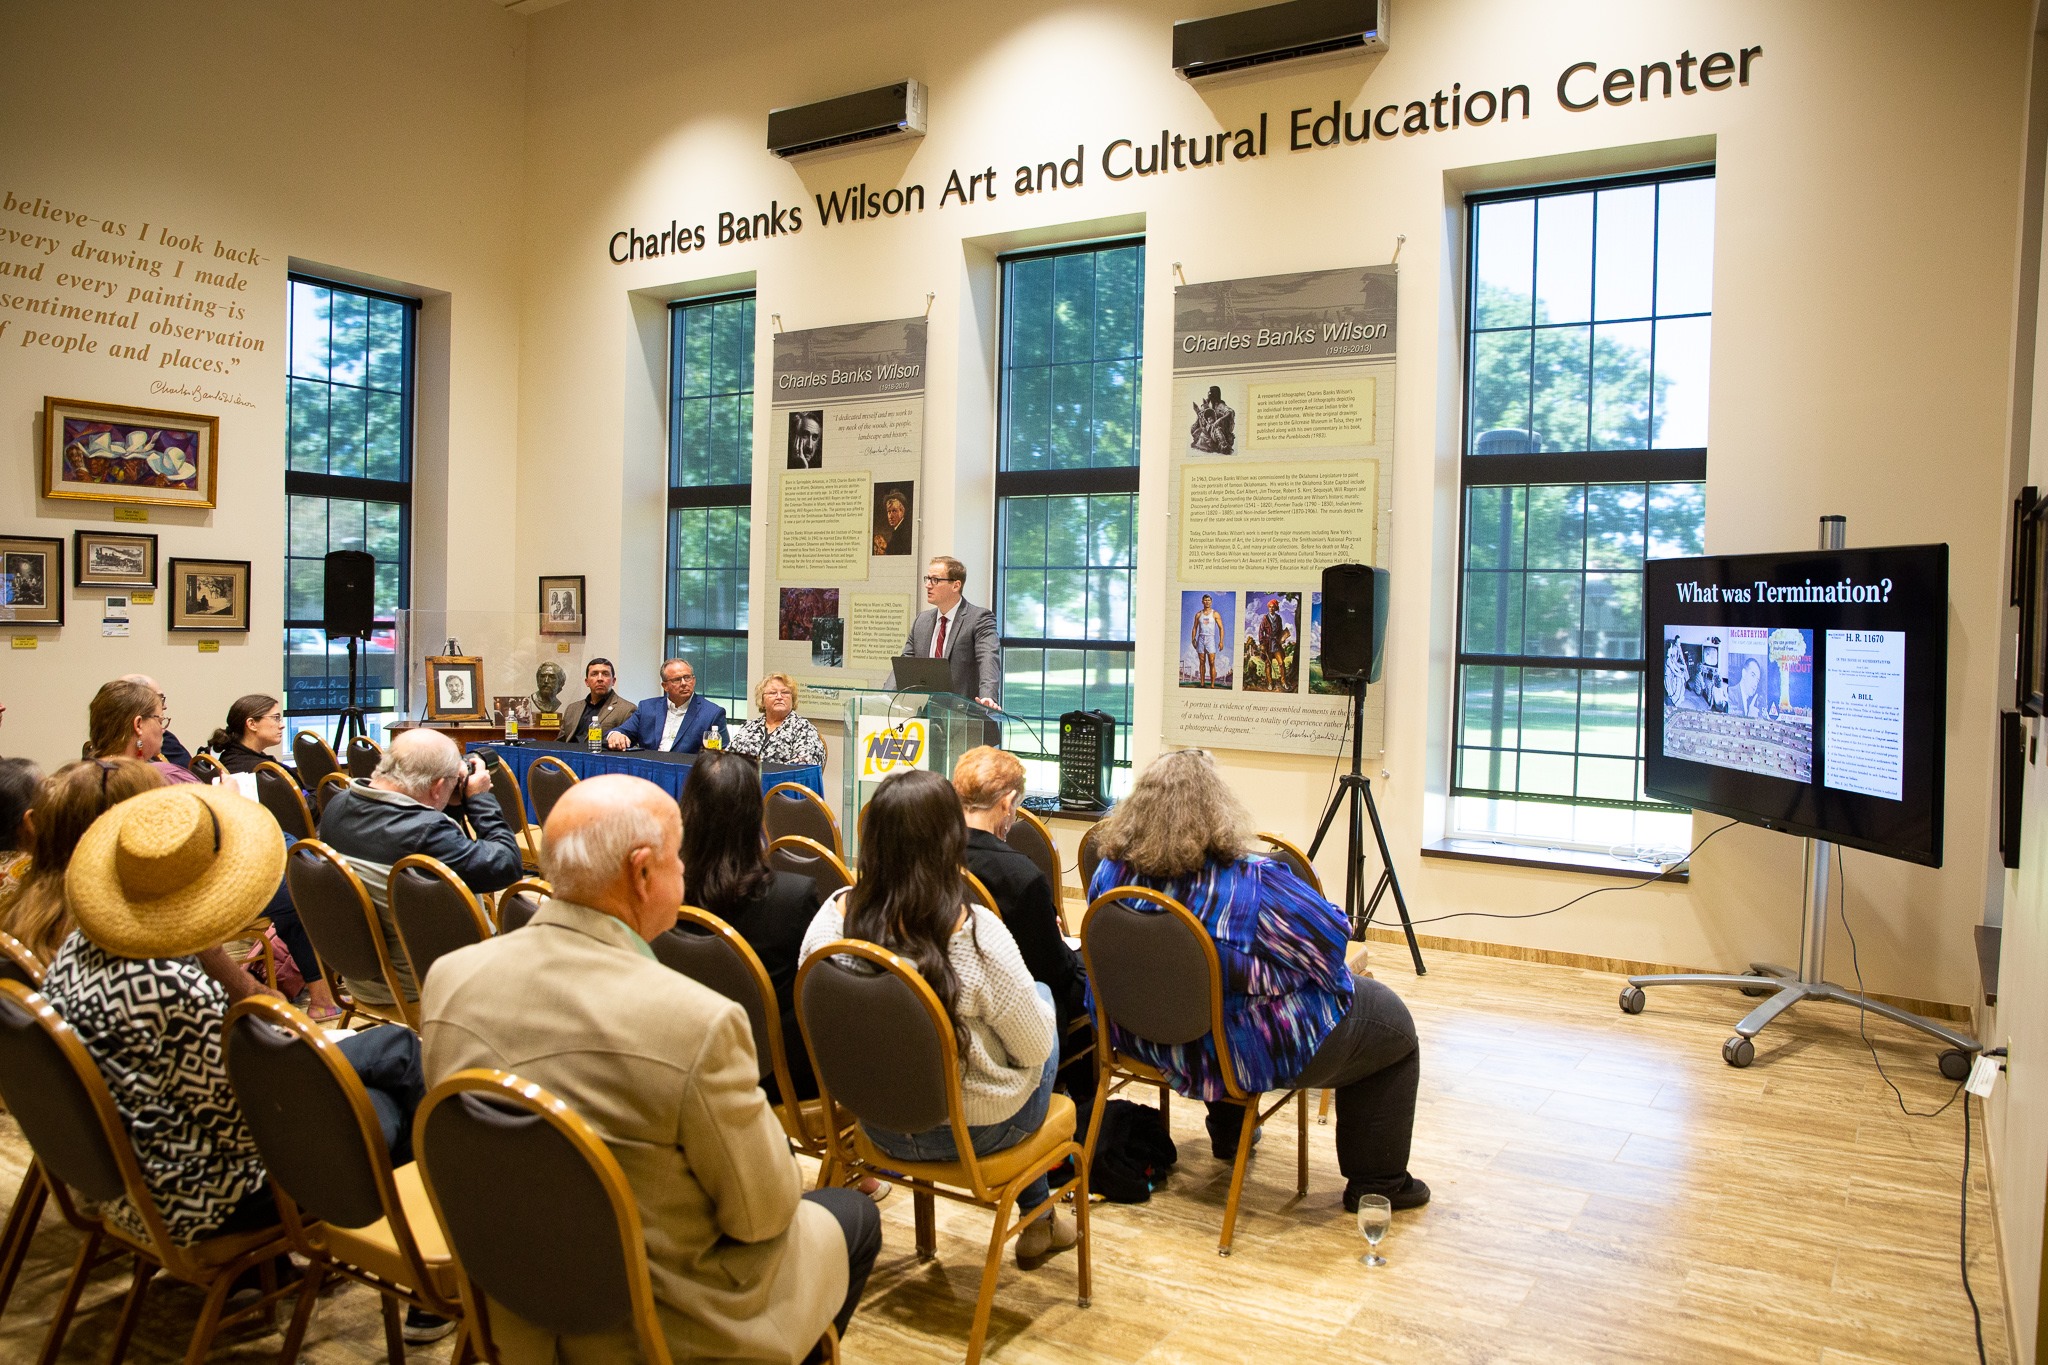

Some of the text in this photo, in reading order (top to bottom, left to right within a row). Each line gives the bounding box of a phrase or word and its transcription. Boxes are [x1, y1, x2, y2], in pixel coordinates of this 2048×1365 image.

[608, 45, 1764, 267] Charles Banks Wilson Art and Cultural Education Center
[138, 222, 150, 242] I
[159, 227, 204, 254] look
[0, 227, 248, 292] every drawing I made
[0, 261, 45, 282] and
[56, 273, 118, 299] every
[0, 293, 265, 352] sentimental observation
[20, 330, 98, 354] people
[109, 344, 151, 362] and
[1182, 322, 1388, 353] Charles Banks Wilson
[1325, 344, 1372, 355] (1918-2013)
[779, 364, 920, 390] Charles Banks Wilson
[862, 412, 877, 420] myself
[1676, 578, 1892, 603] What was Termination?
[1846, 633, 1854, 642] H.
[1855, 633, 1861, 642] R.
[1864, 634, 1884, 643] 11670
[1245, 704, 1253, 712] of
[1270, 706, 1301, 714] assembled
[1858, 693, 1873, 701] BILL
[1185, 723, 1221, 732] photographic
[1260, 717, 1281, 725] totality
[1282, 717, 1290, 726] of
[1290, 719, 1321, 727] experience
[867, 738, 921, 762] NEO
